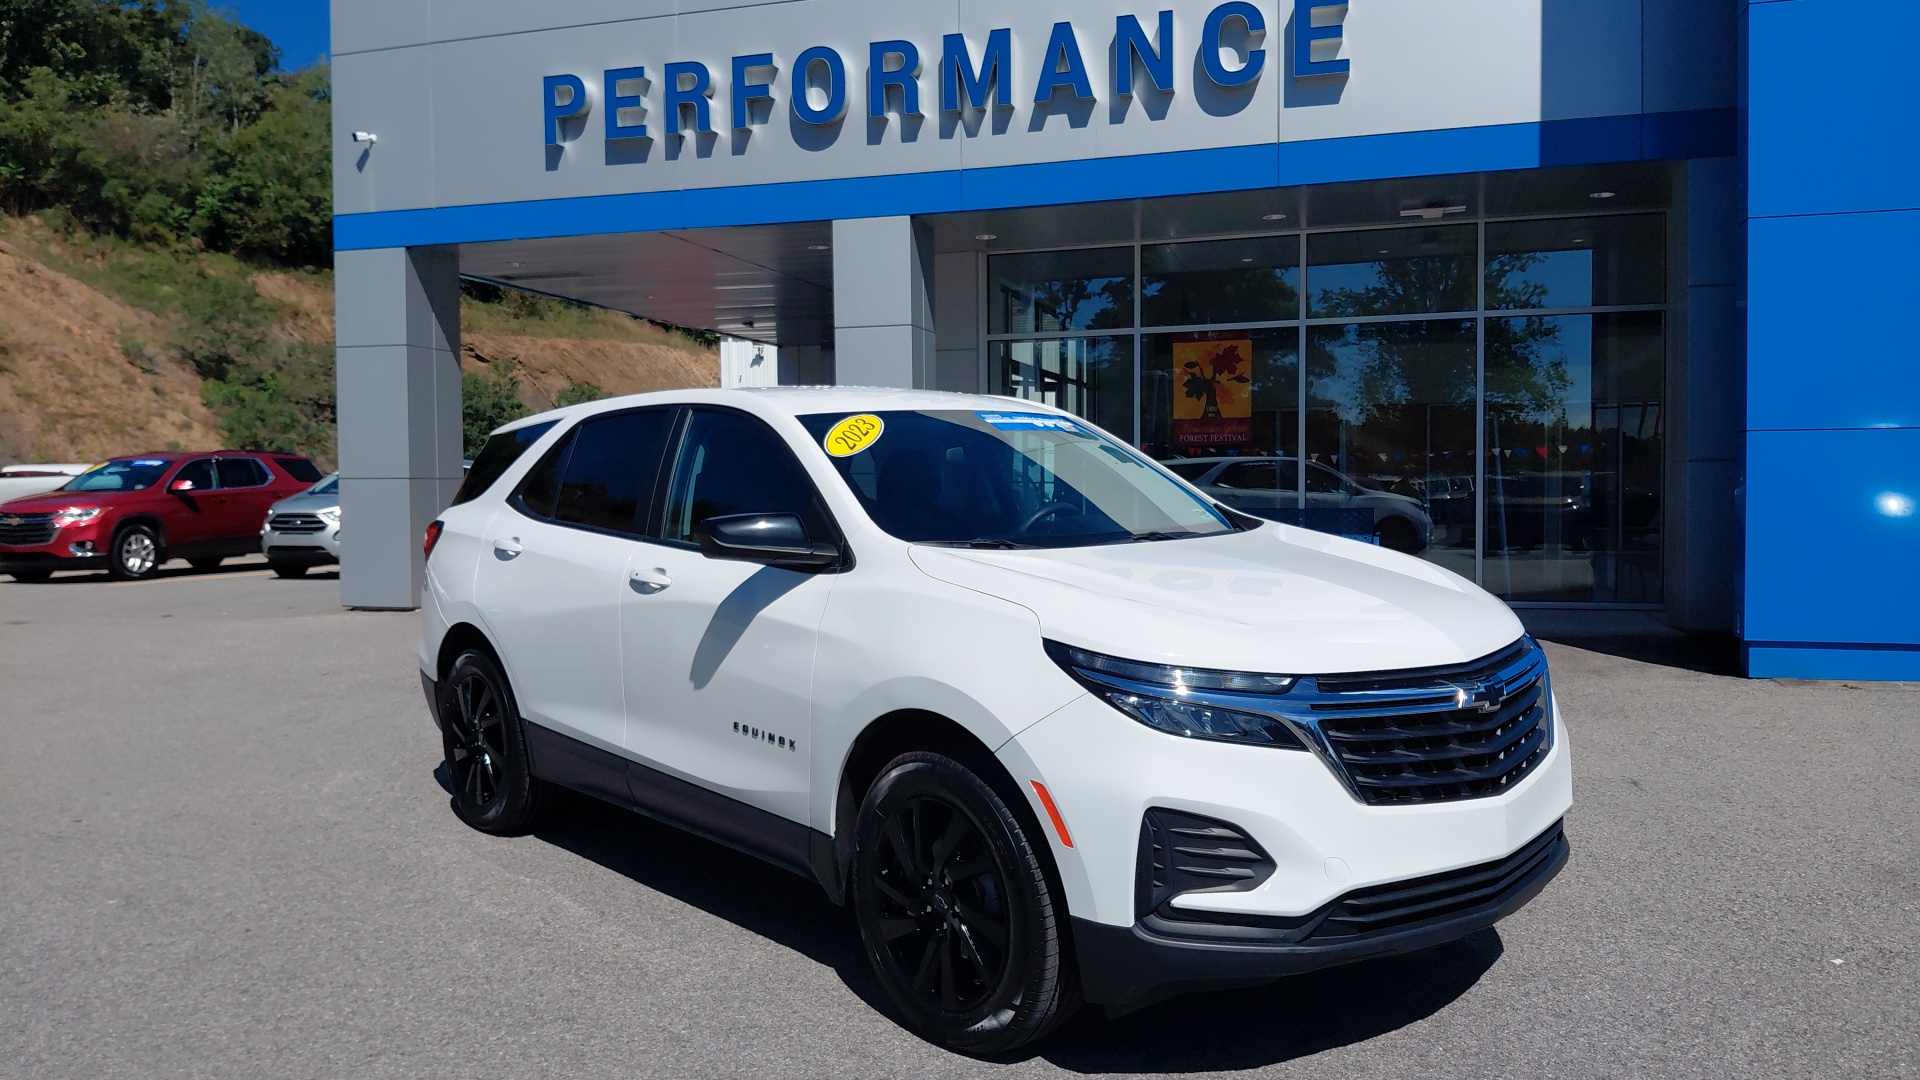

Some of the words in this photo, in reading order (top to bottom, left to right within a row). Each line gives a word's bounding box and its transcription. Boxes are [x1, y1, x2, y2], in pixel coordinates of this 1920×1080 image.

[543, 0, 1350, 147] PERFORMANCE
[835, 418, 876, 450] 2023
[1180, 434, 1208, 442] FOREST
[1210, 433, 1248, 442] FESTIVAL
[733, 721, 796, 750] EQUINOX
